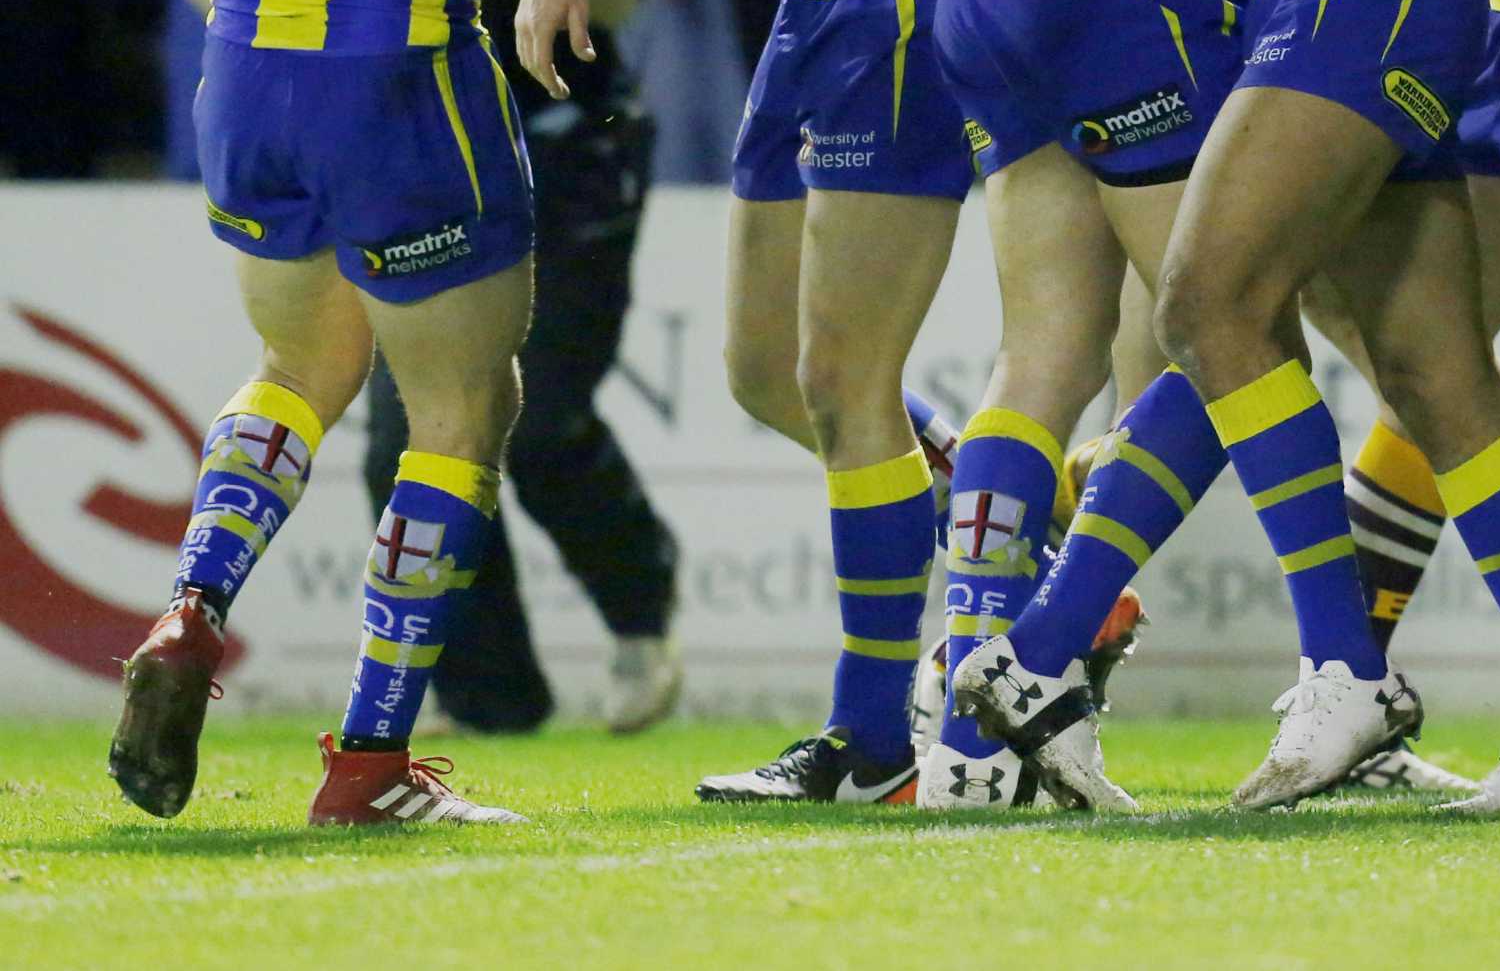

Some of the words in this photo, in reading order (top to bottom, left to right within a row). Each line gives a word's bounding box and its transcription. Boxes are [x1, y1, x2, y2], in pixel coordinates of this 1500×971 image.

[1104, 91, 1185, 132] matrix
[1114, 110, 1194, 145] networks
[813, 132, 859, 147] versity
[862, 130, 877, 143] of
[810, 150, 875, 169] hester
[384, 224, 467, 261] matrix
[387, 243, 472, 275] networks
[175, 483, 259, 582] Chster
[373, 719, 391, 739] of
